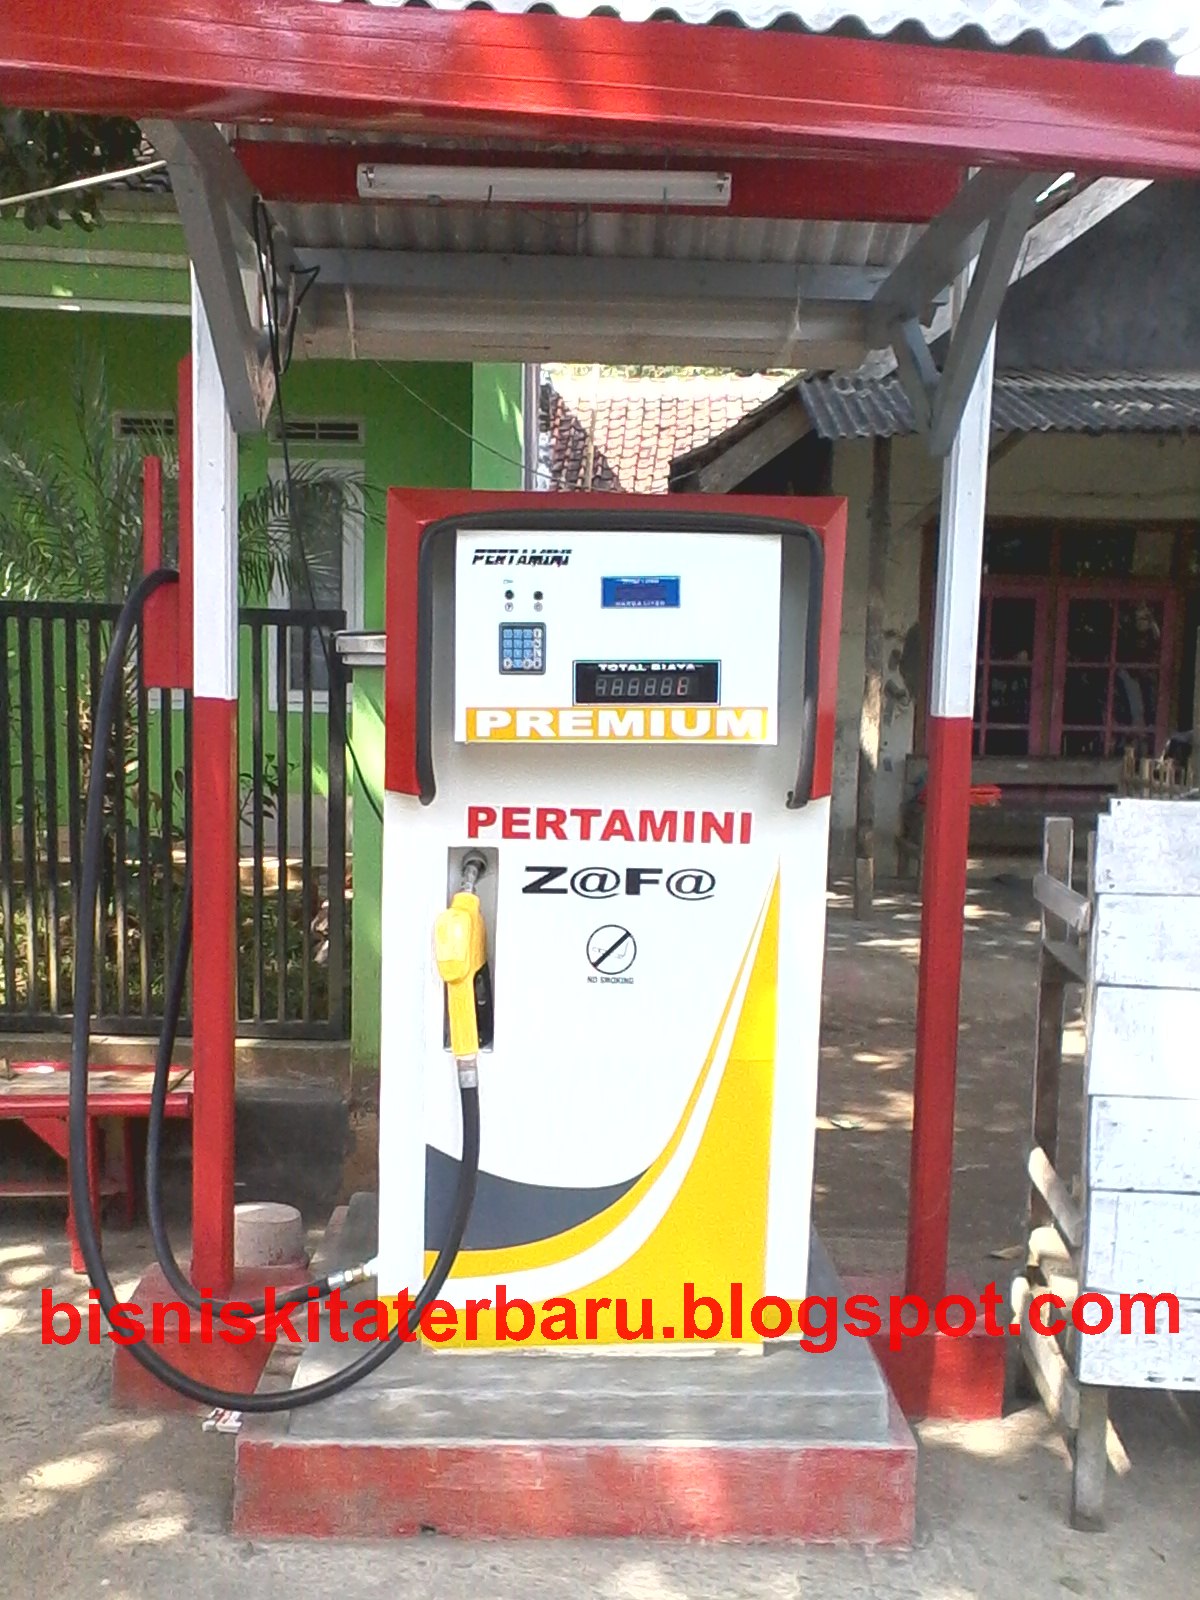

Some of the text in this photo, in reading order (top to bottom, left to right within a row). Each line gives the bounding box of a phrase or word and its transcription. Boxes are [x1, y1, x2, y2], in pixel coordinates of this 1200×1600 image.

[598, 663, 696, 672] TOTAL BIAYA
[475, 709, 762, 738] PREMIUM
[467, 806, 752, 844] PERTAMINI
[522, 866, 716, 901] Z@F@
[600, 976, 634, 984] SMOKING
